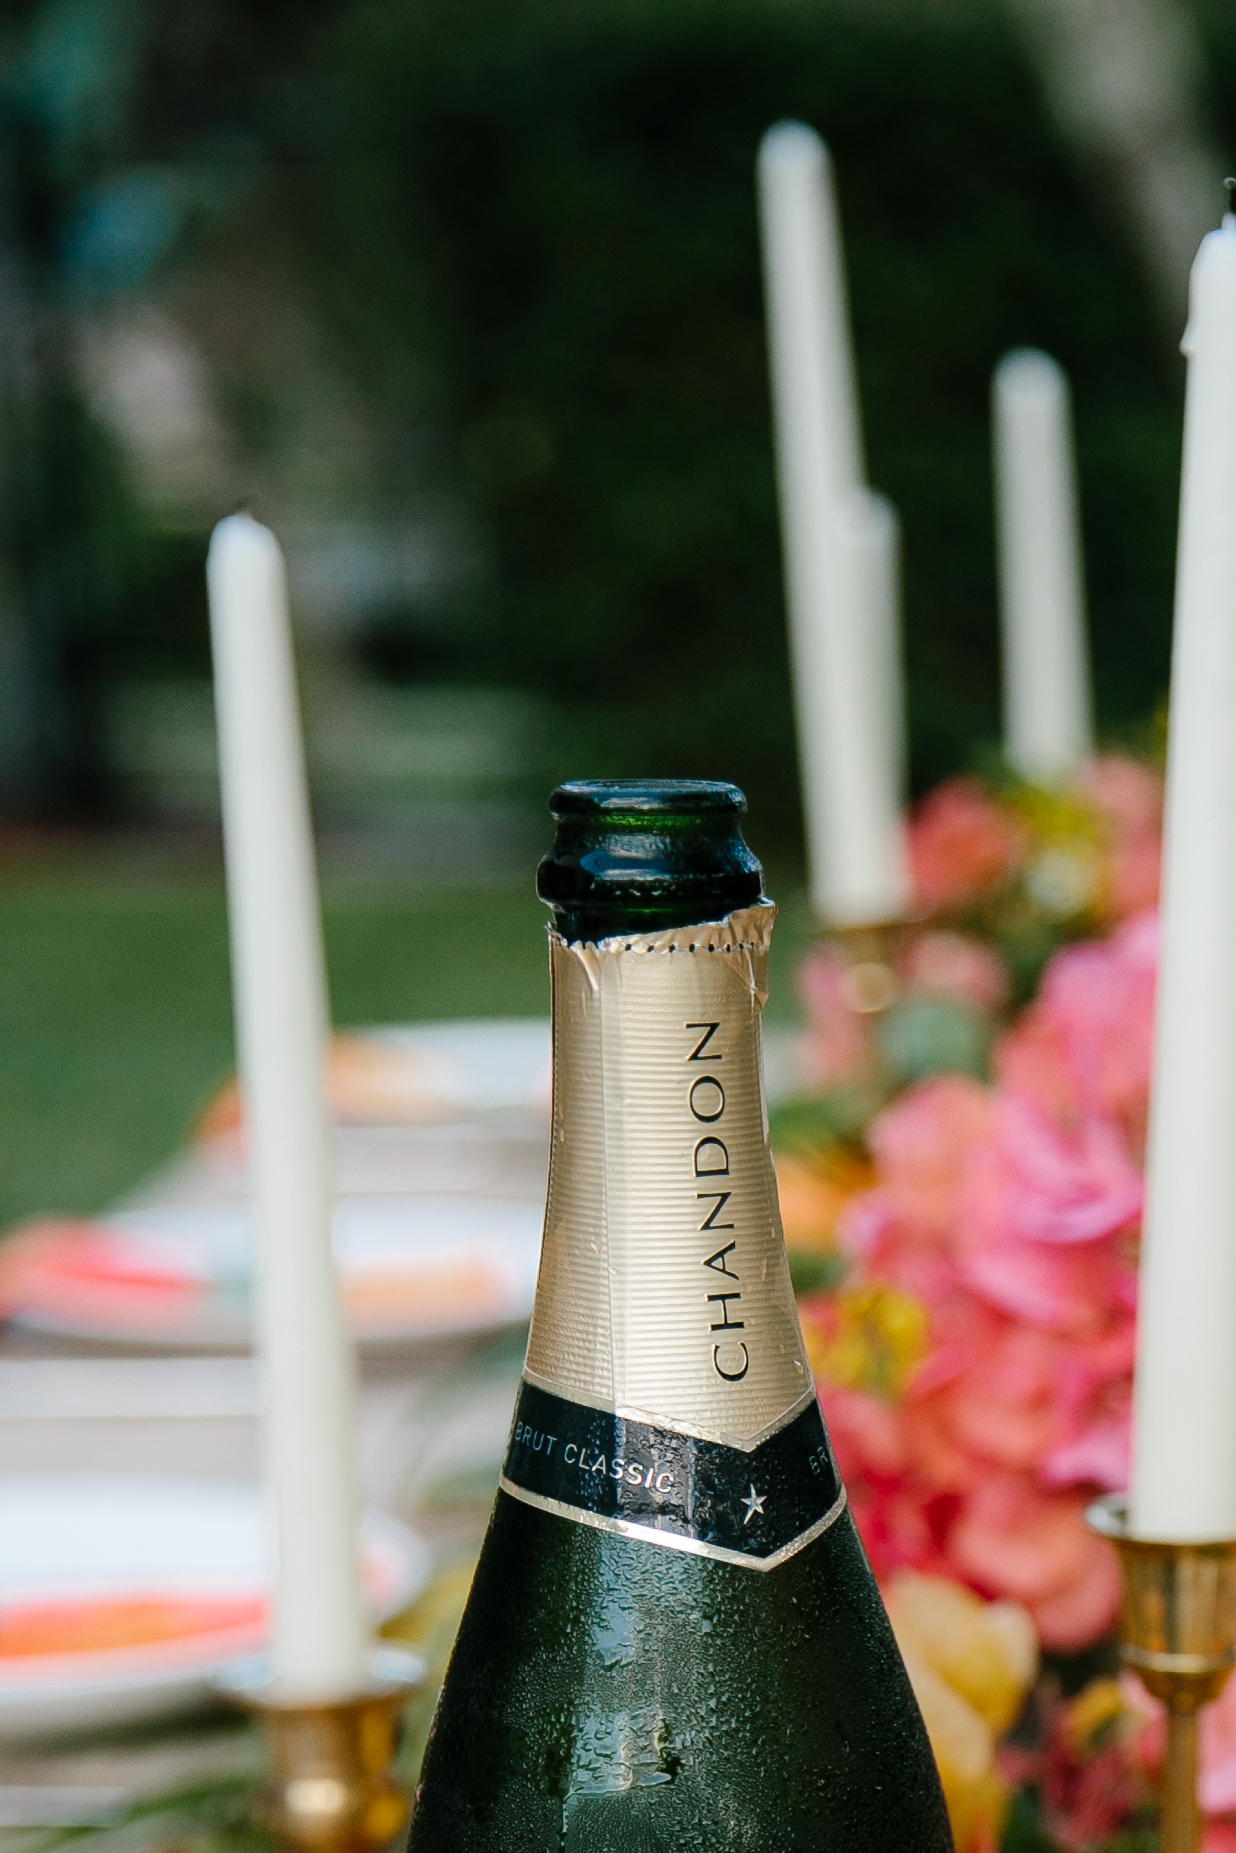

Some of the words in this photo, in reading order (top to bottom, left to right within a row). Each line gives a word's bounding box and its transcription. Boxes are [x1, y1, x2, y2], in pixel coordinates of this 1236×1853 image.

[685, 1021, 750, 1382] CHANDON
[515, 1421, 558, 1455] BRUT
[564, 1443, 674, 1493] CLASSIC
